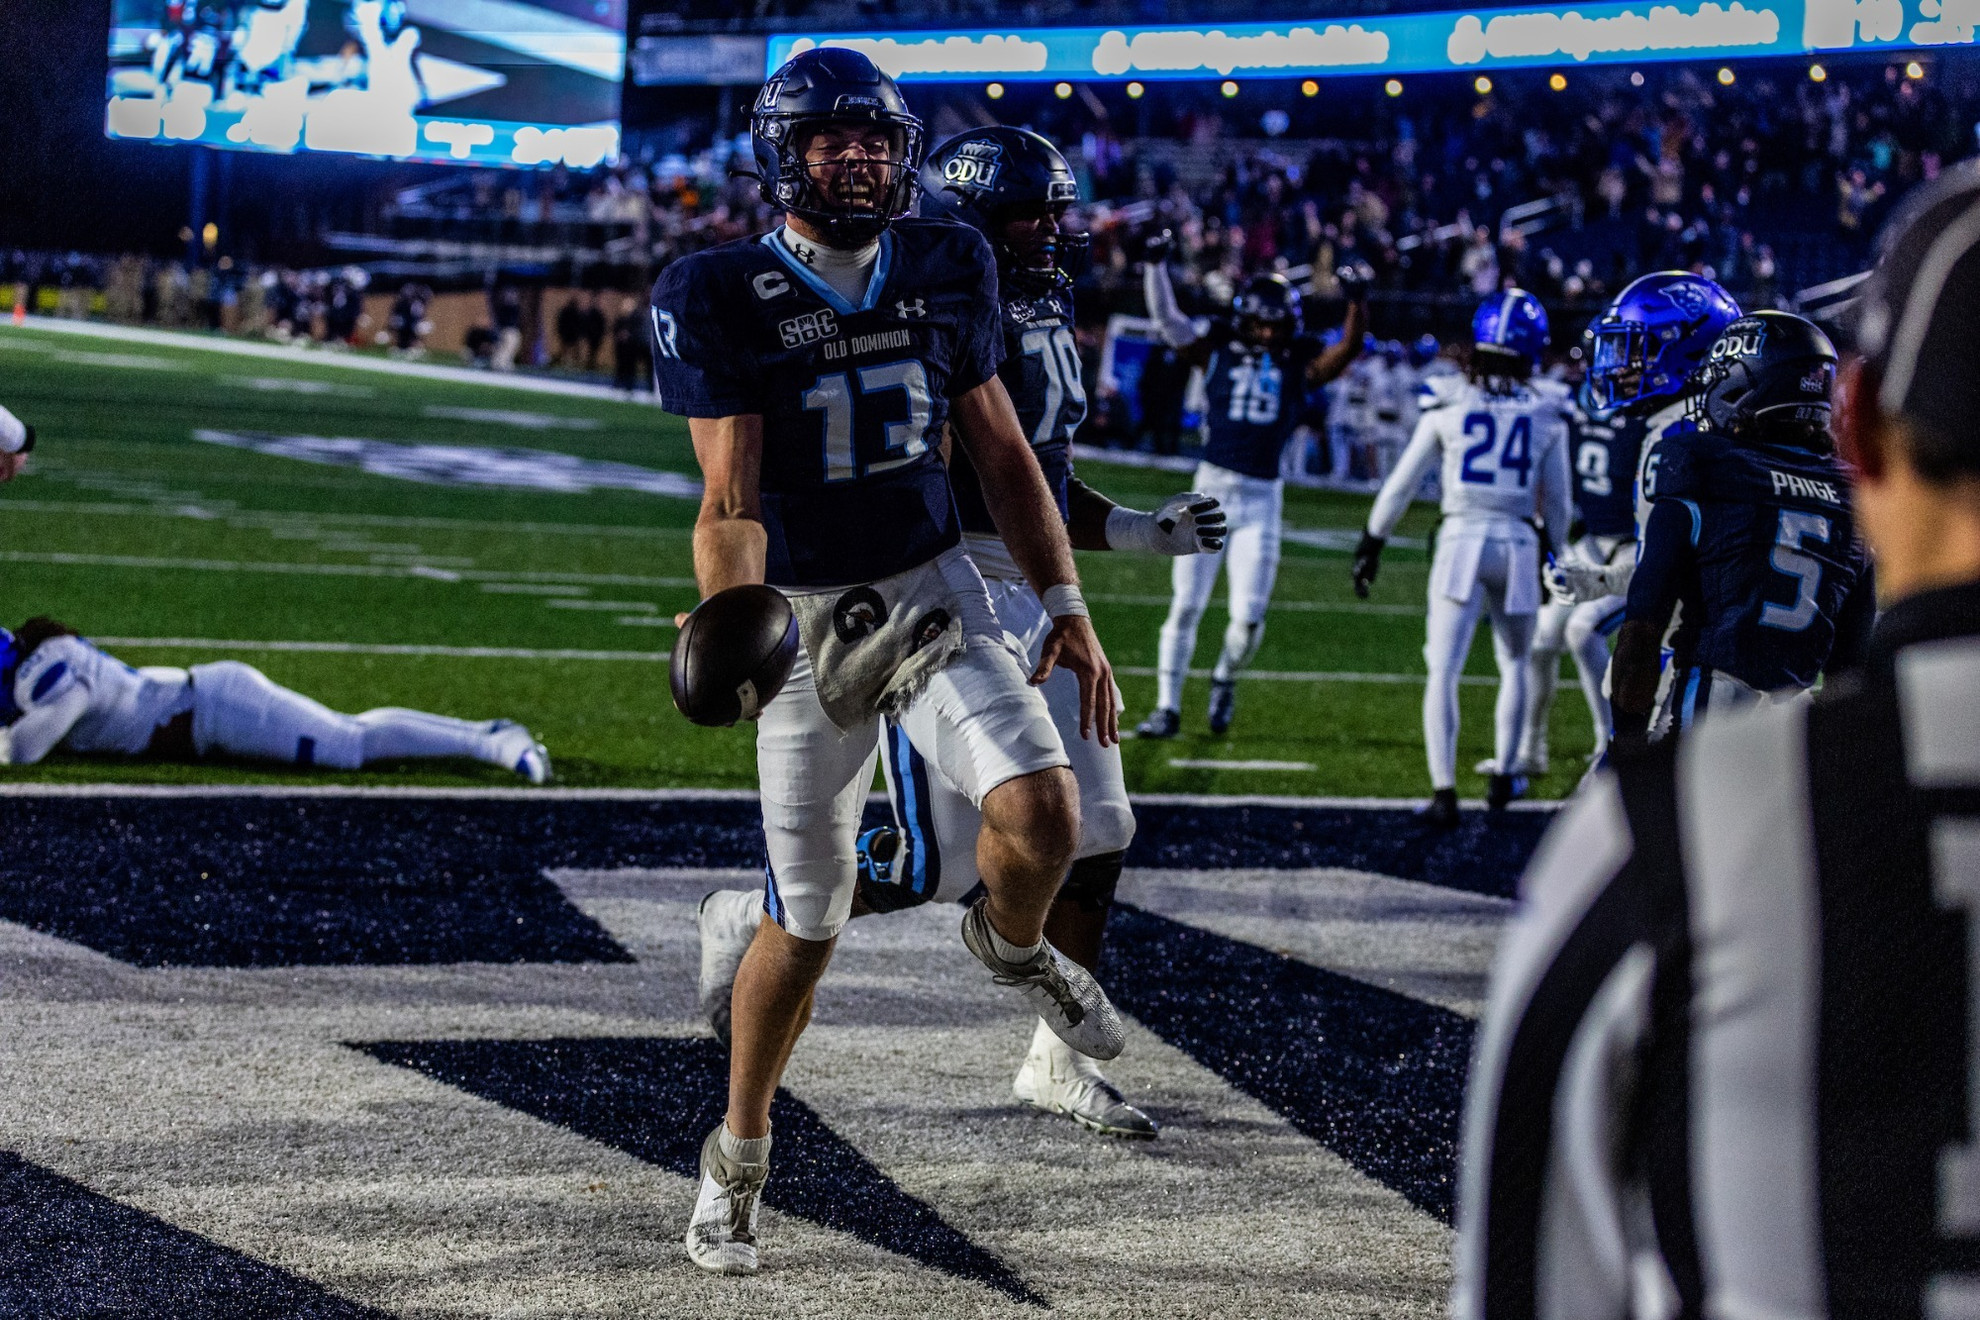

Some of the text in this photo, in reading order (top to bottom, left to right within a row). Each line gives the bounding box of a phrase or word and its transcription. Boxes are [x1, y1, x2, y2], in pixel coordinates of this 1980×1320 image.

[944, 157, 996, 187] ODU
[753, 271, 790, 299] C
[778, 308, 838, 349] SBC
[824, 329, 910, 360] OLD DOMINION
[1711, 335, 1761, 358] ODU
[1021, 325, 1088, 445] 79
[801, 358, 931, 484] 13
[1461, 411, 1532, 487] 24
[1576, 441, 1613, 497] 9
[1770, 470, 1841, 505] PAIGE
[1758, 508, 1833, 632] 5
